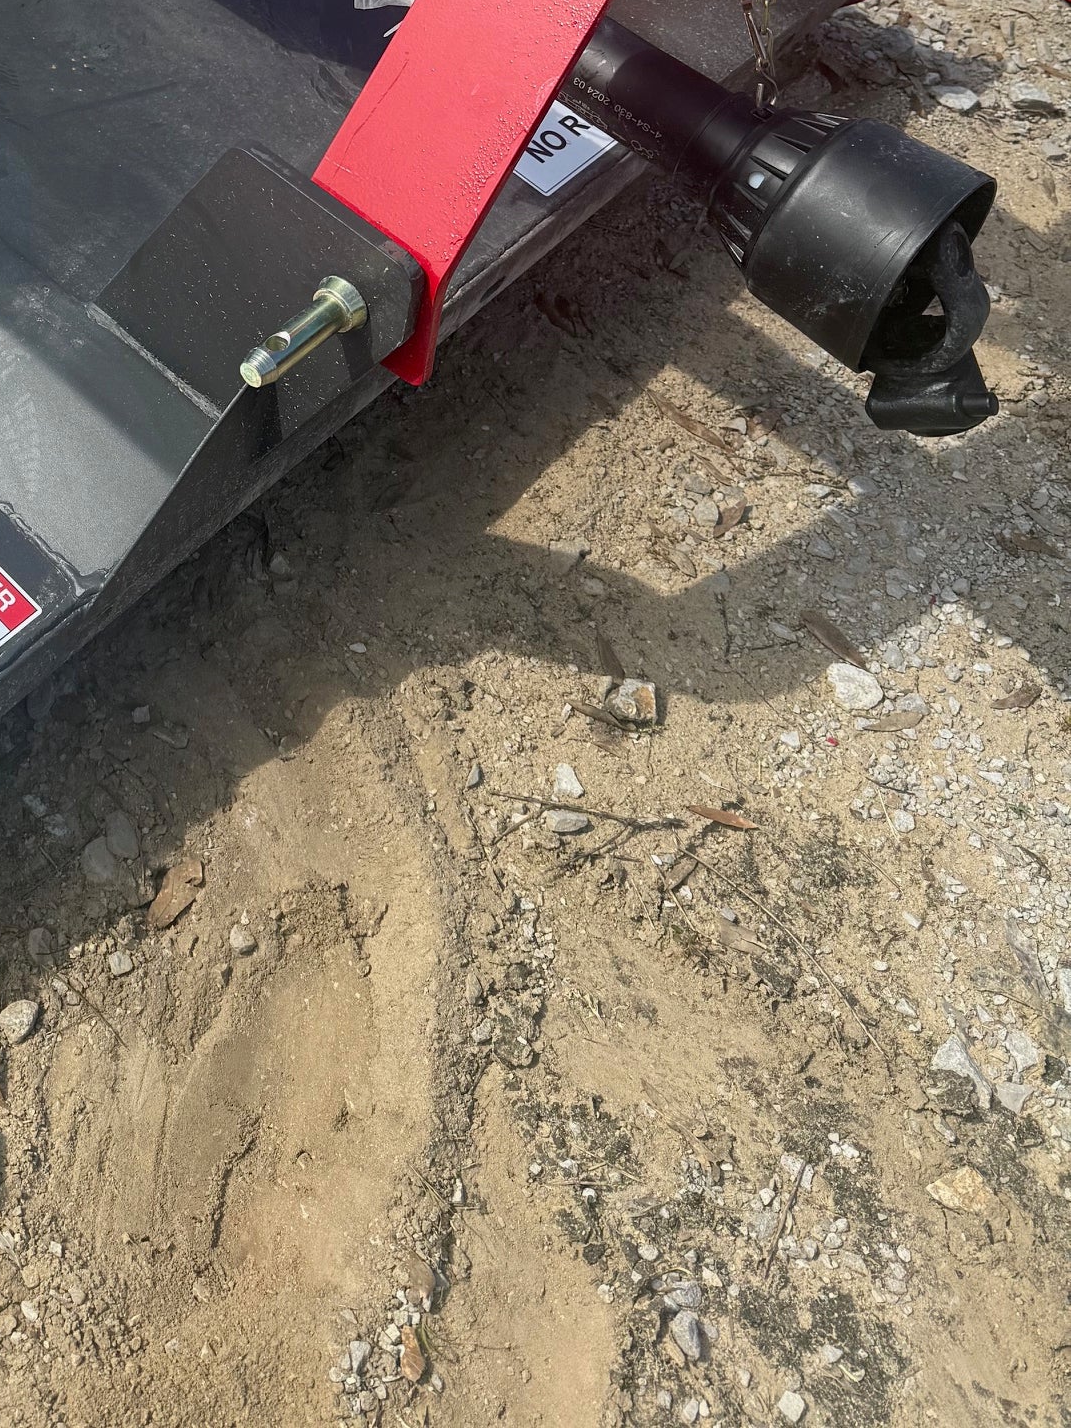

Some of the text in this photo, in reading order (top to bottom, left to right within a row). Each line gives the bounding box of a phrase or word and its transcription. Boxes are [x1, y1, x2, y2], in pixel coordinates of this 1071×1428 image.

[572, 76, 587, 90] 03
[586, 86, 611, 106] 2024
[525, 129, 568, 164] NO
